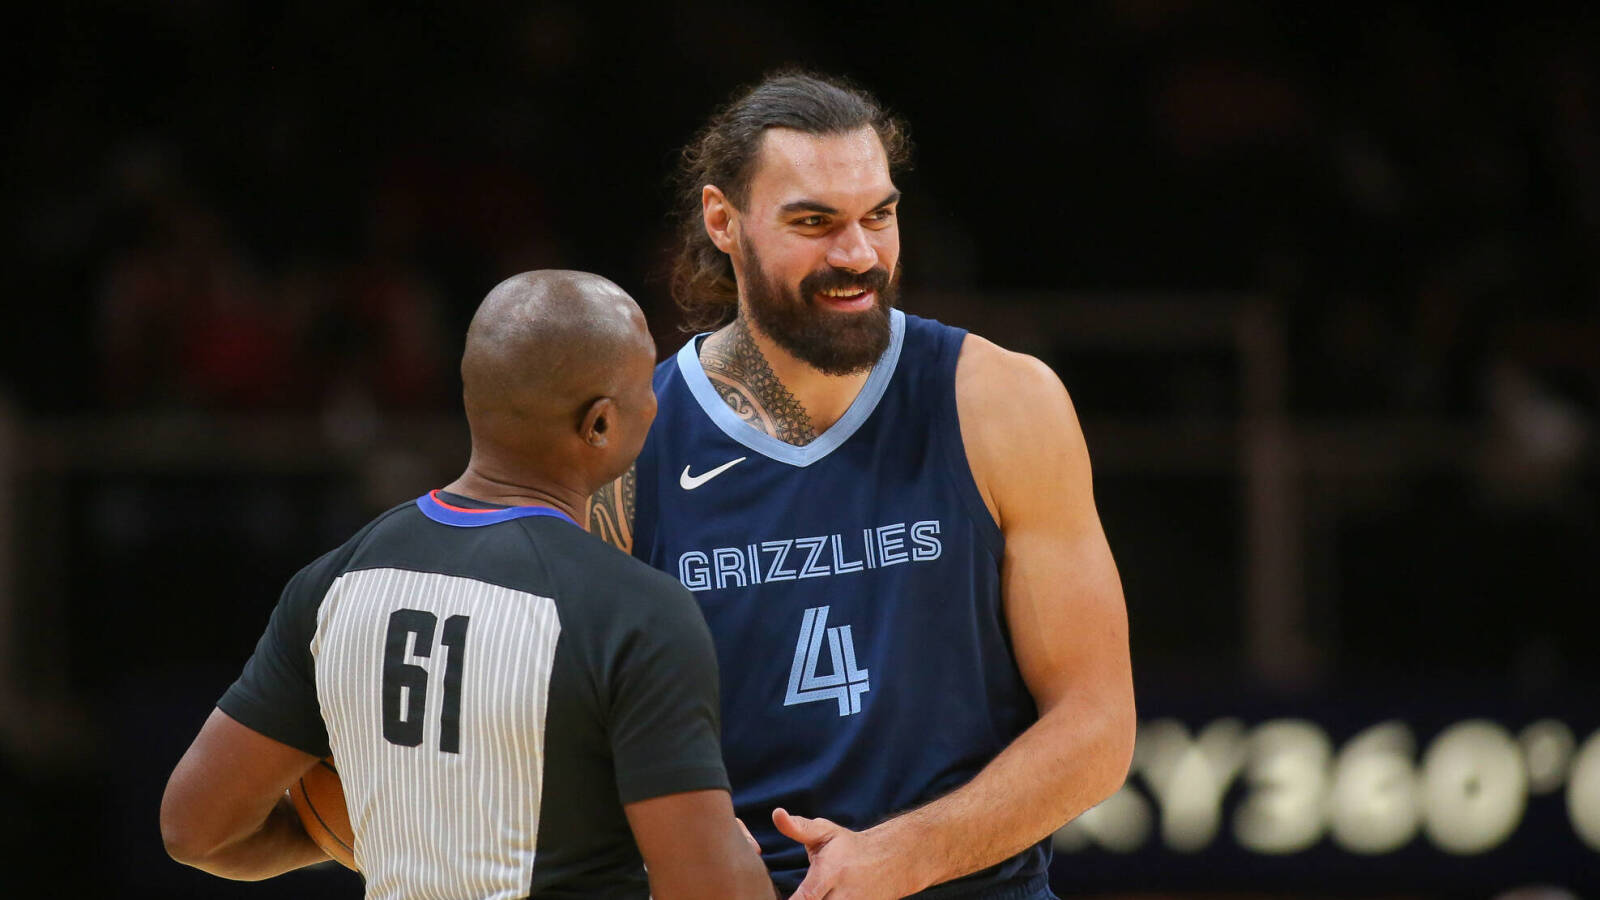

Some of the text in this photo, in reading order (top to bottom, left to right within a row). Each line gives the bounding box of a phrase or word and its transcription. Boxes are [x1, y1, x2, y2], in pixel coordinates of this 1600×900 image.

[678, 520, 942, 592] GRIZZLIES
[382, 608, 470, 754] 61
[783, 605, 870, 717] 4
